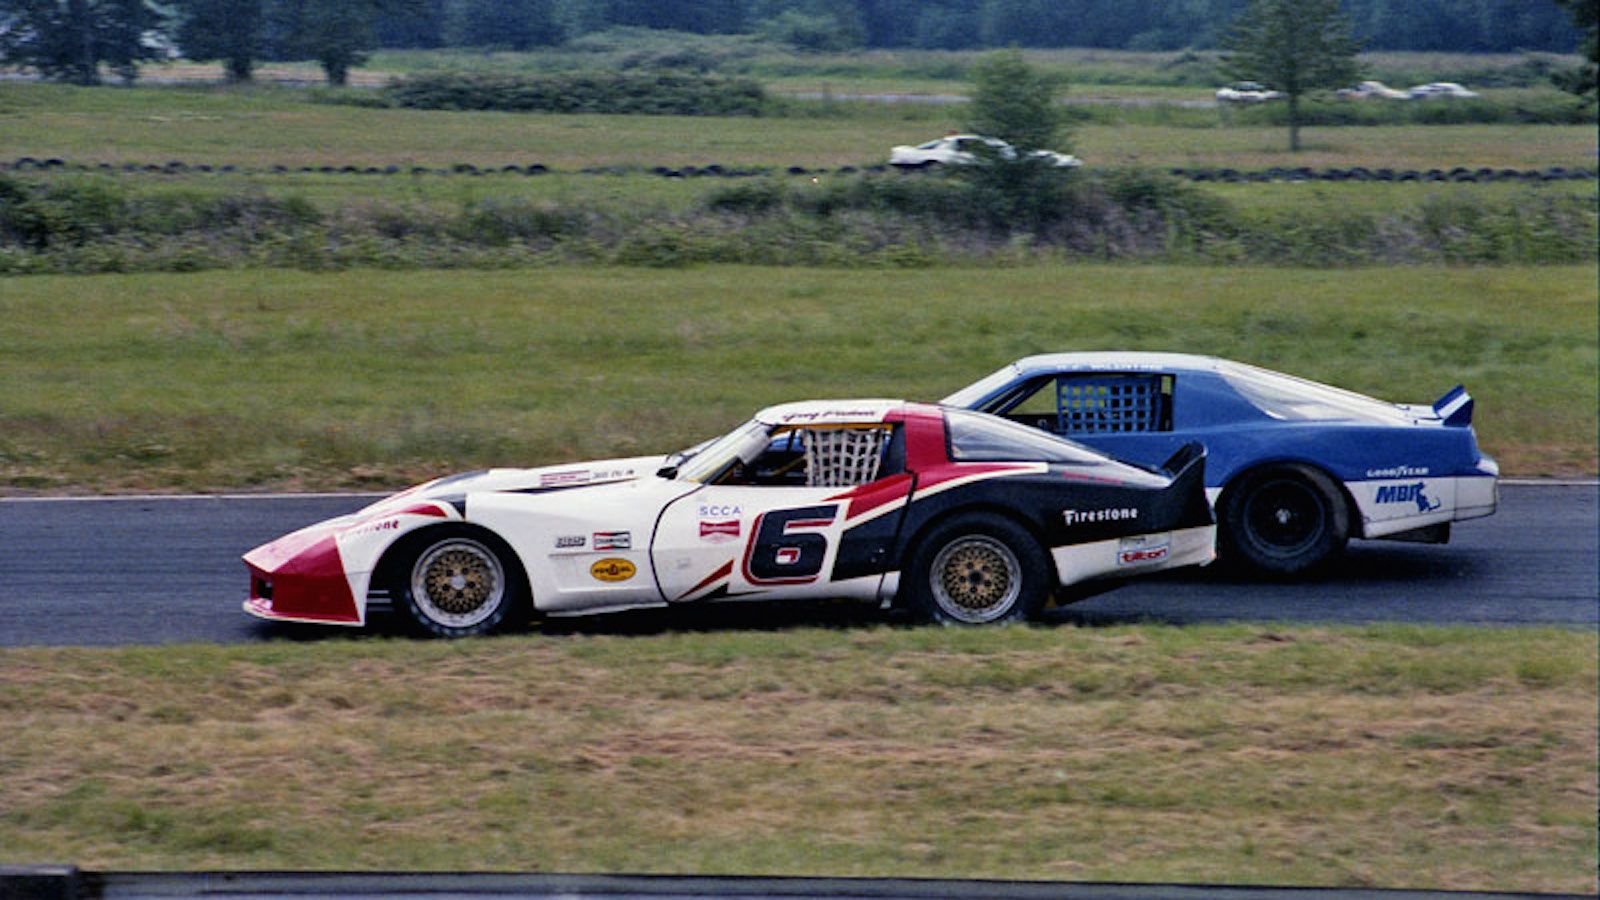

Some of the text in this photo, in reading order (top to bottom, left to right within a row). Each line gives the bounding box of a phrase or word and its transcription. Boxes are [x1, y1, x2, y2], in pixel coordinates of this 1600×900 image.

[699, 506, 741, 516] SCCA
[1063, 508, 1138, 526] Firestone
[742, 504, 839, 586] 6
